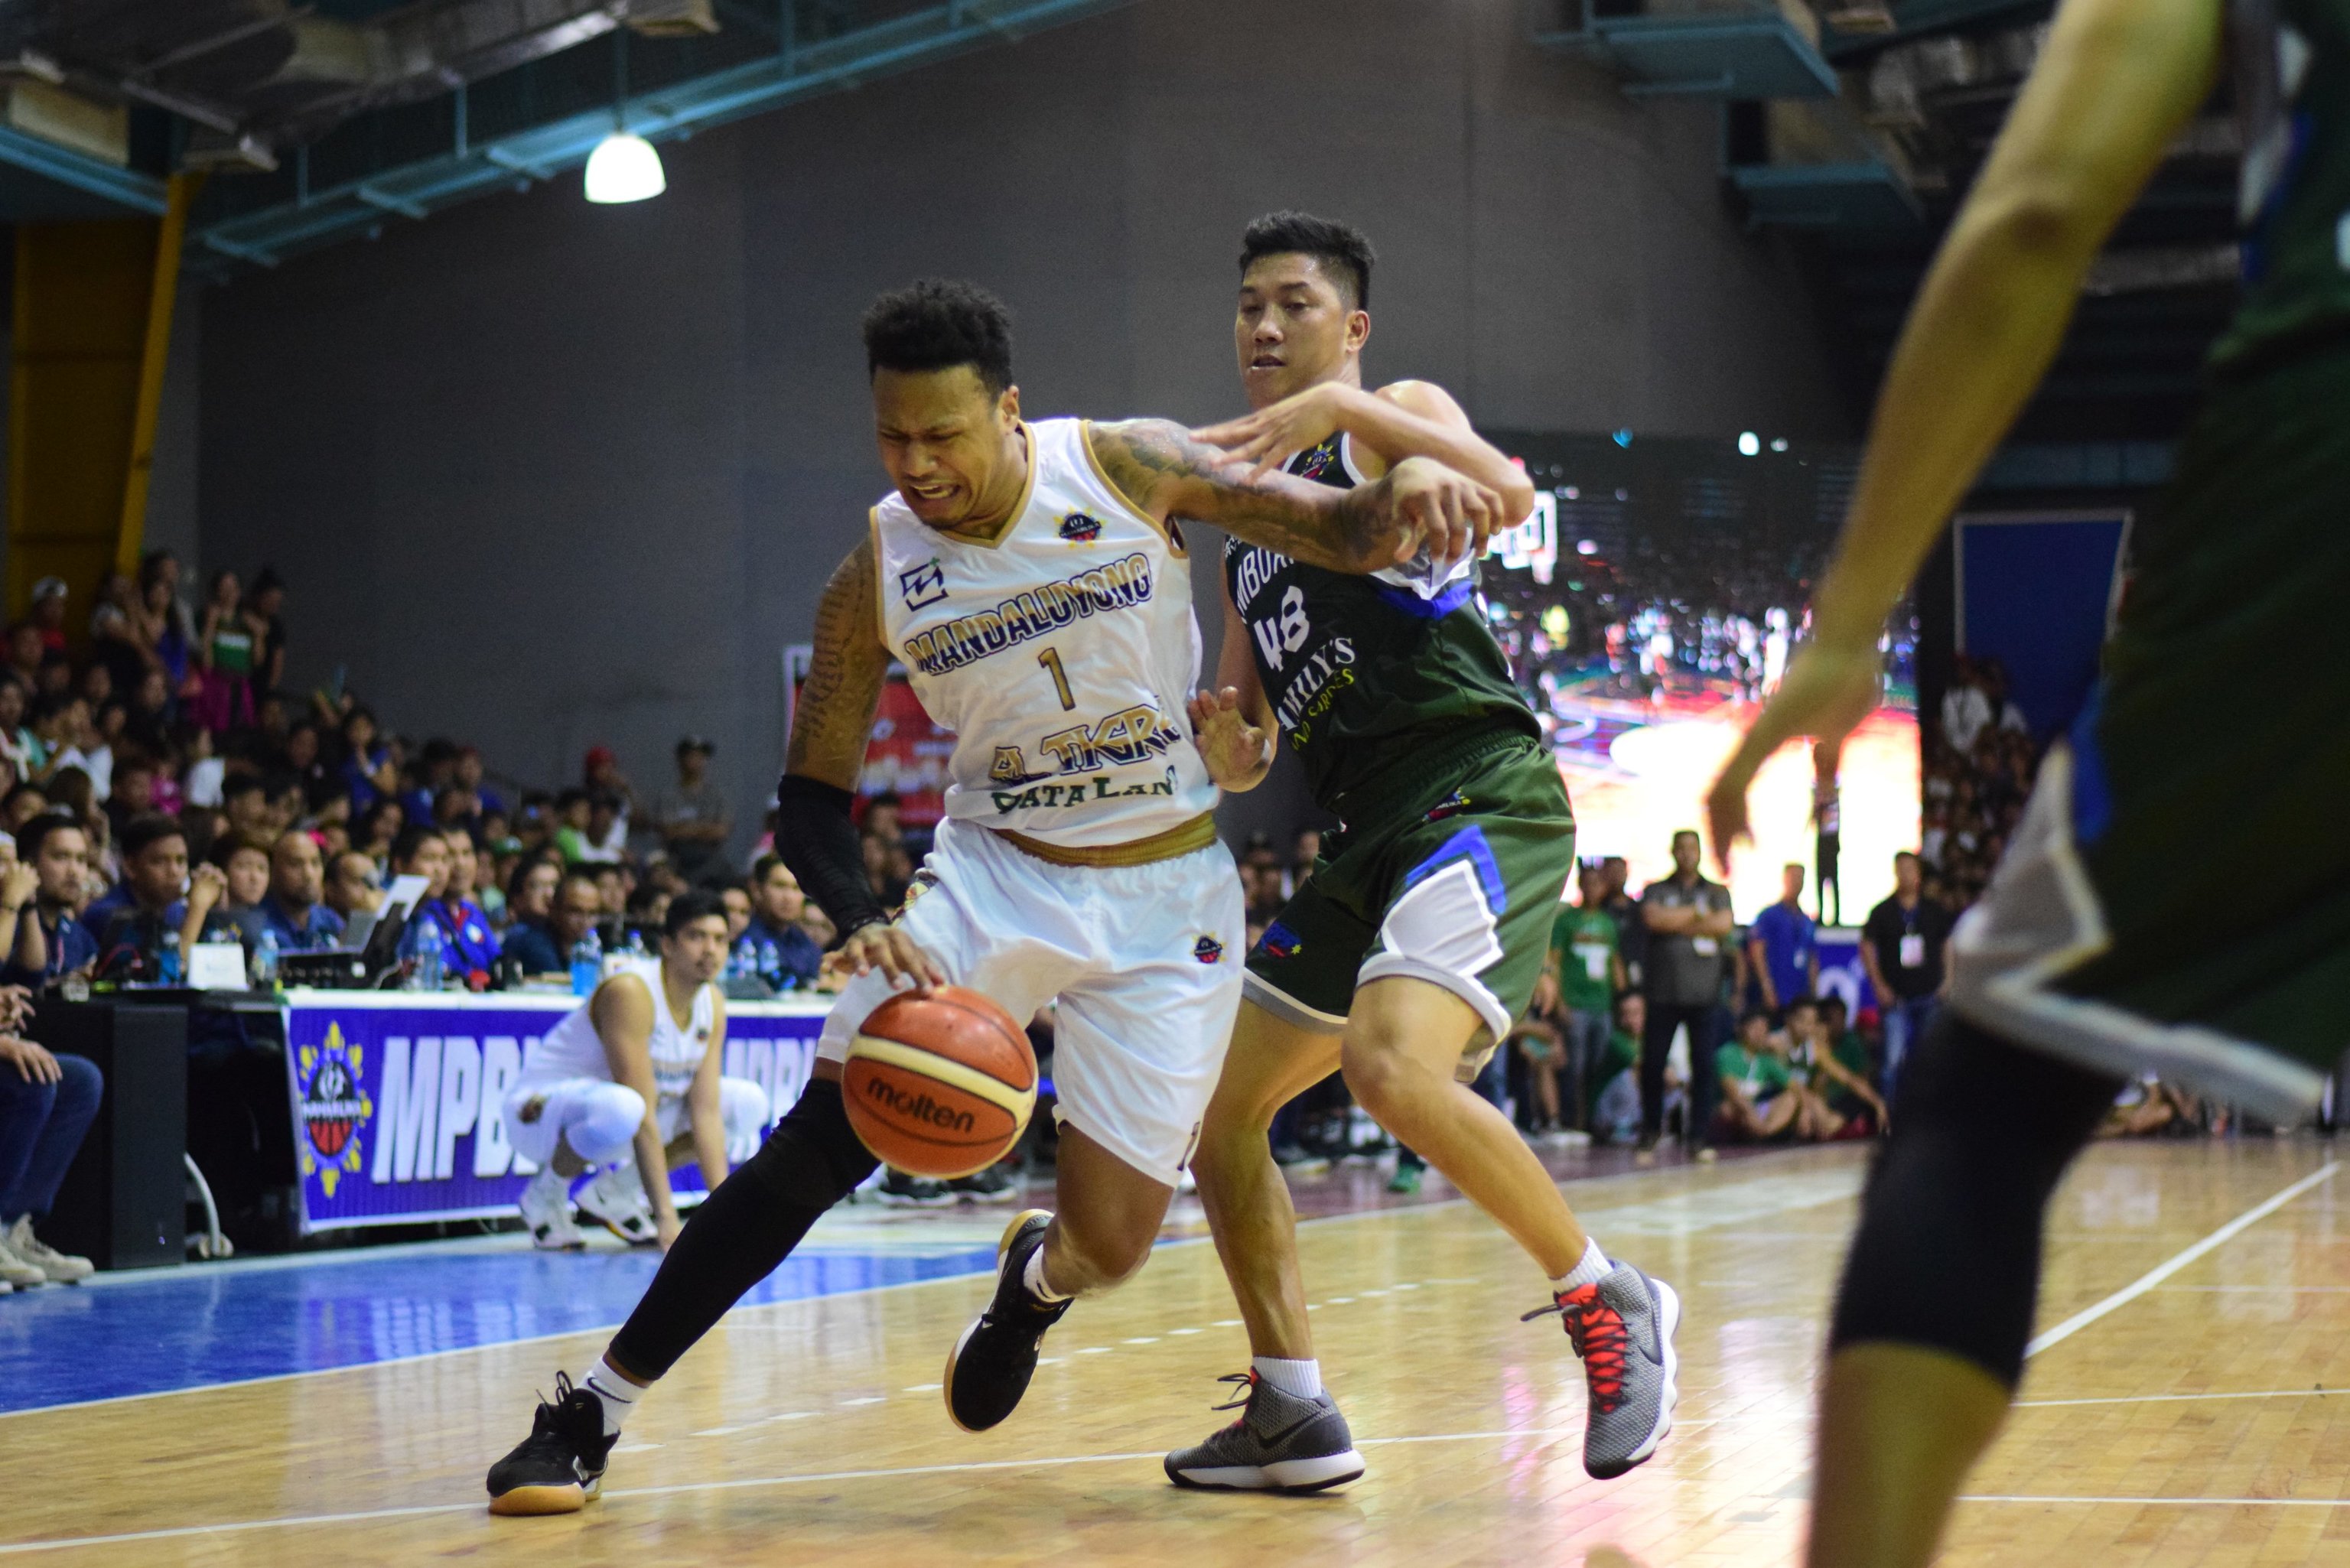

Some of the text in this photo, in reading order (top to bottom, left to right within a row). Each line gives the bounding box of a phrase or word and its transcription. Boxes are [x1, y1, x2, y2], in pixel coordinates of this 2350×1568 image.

[904, 552, 1153, 676] MANDALUYONG
[1254, 585, 1310, 672] 48
[1037, 647, 1076, 711] 1
[1278, 637, 1356, 731] AMILY'S
[867, 1077, 975, 1134] molten
